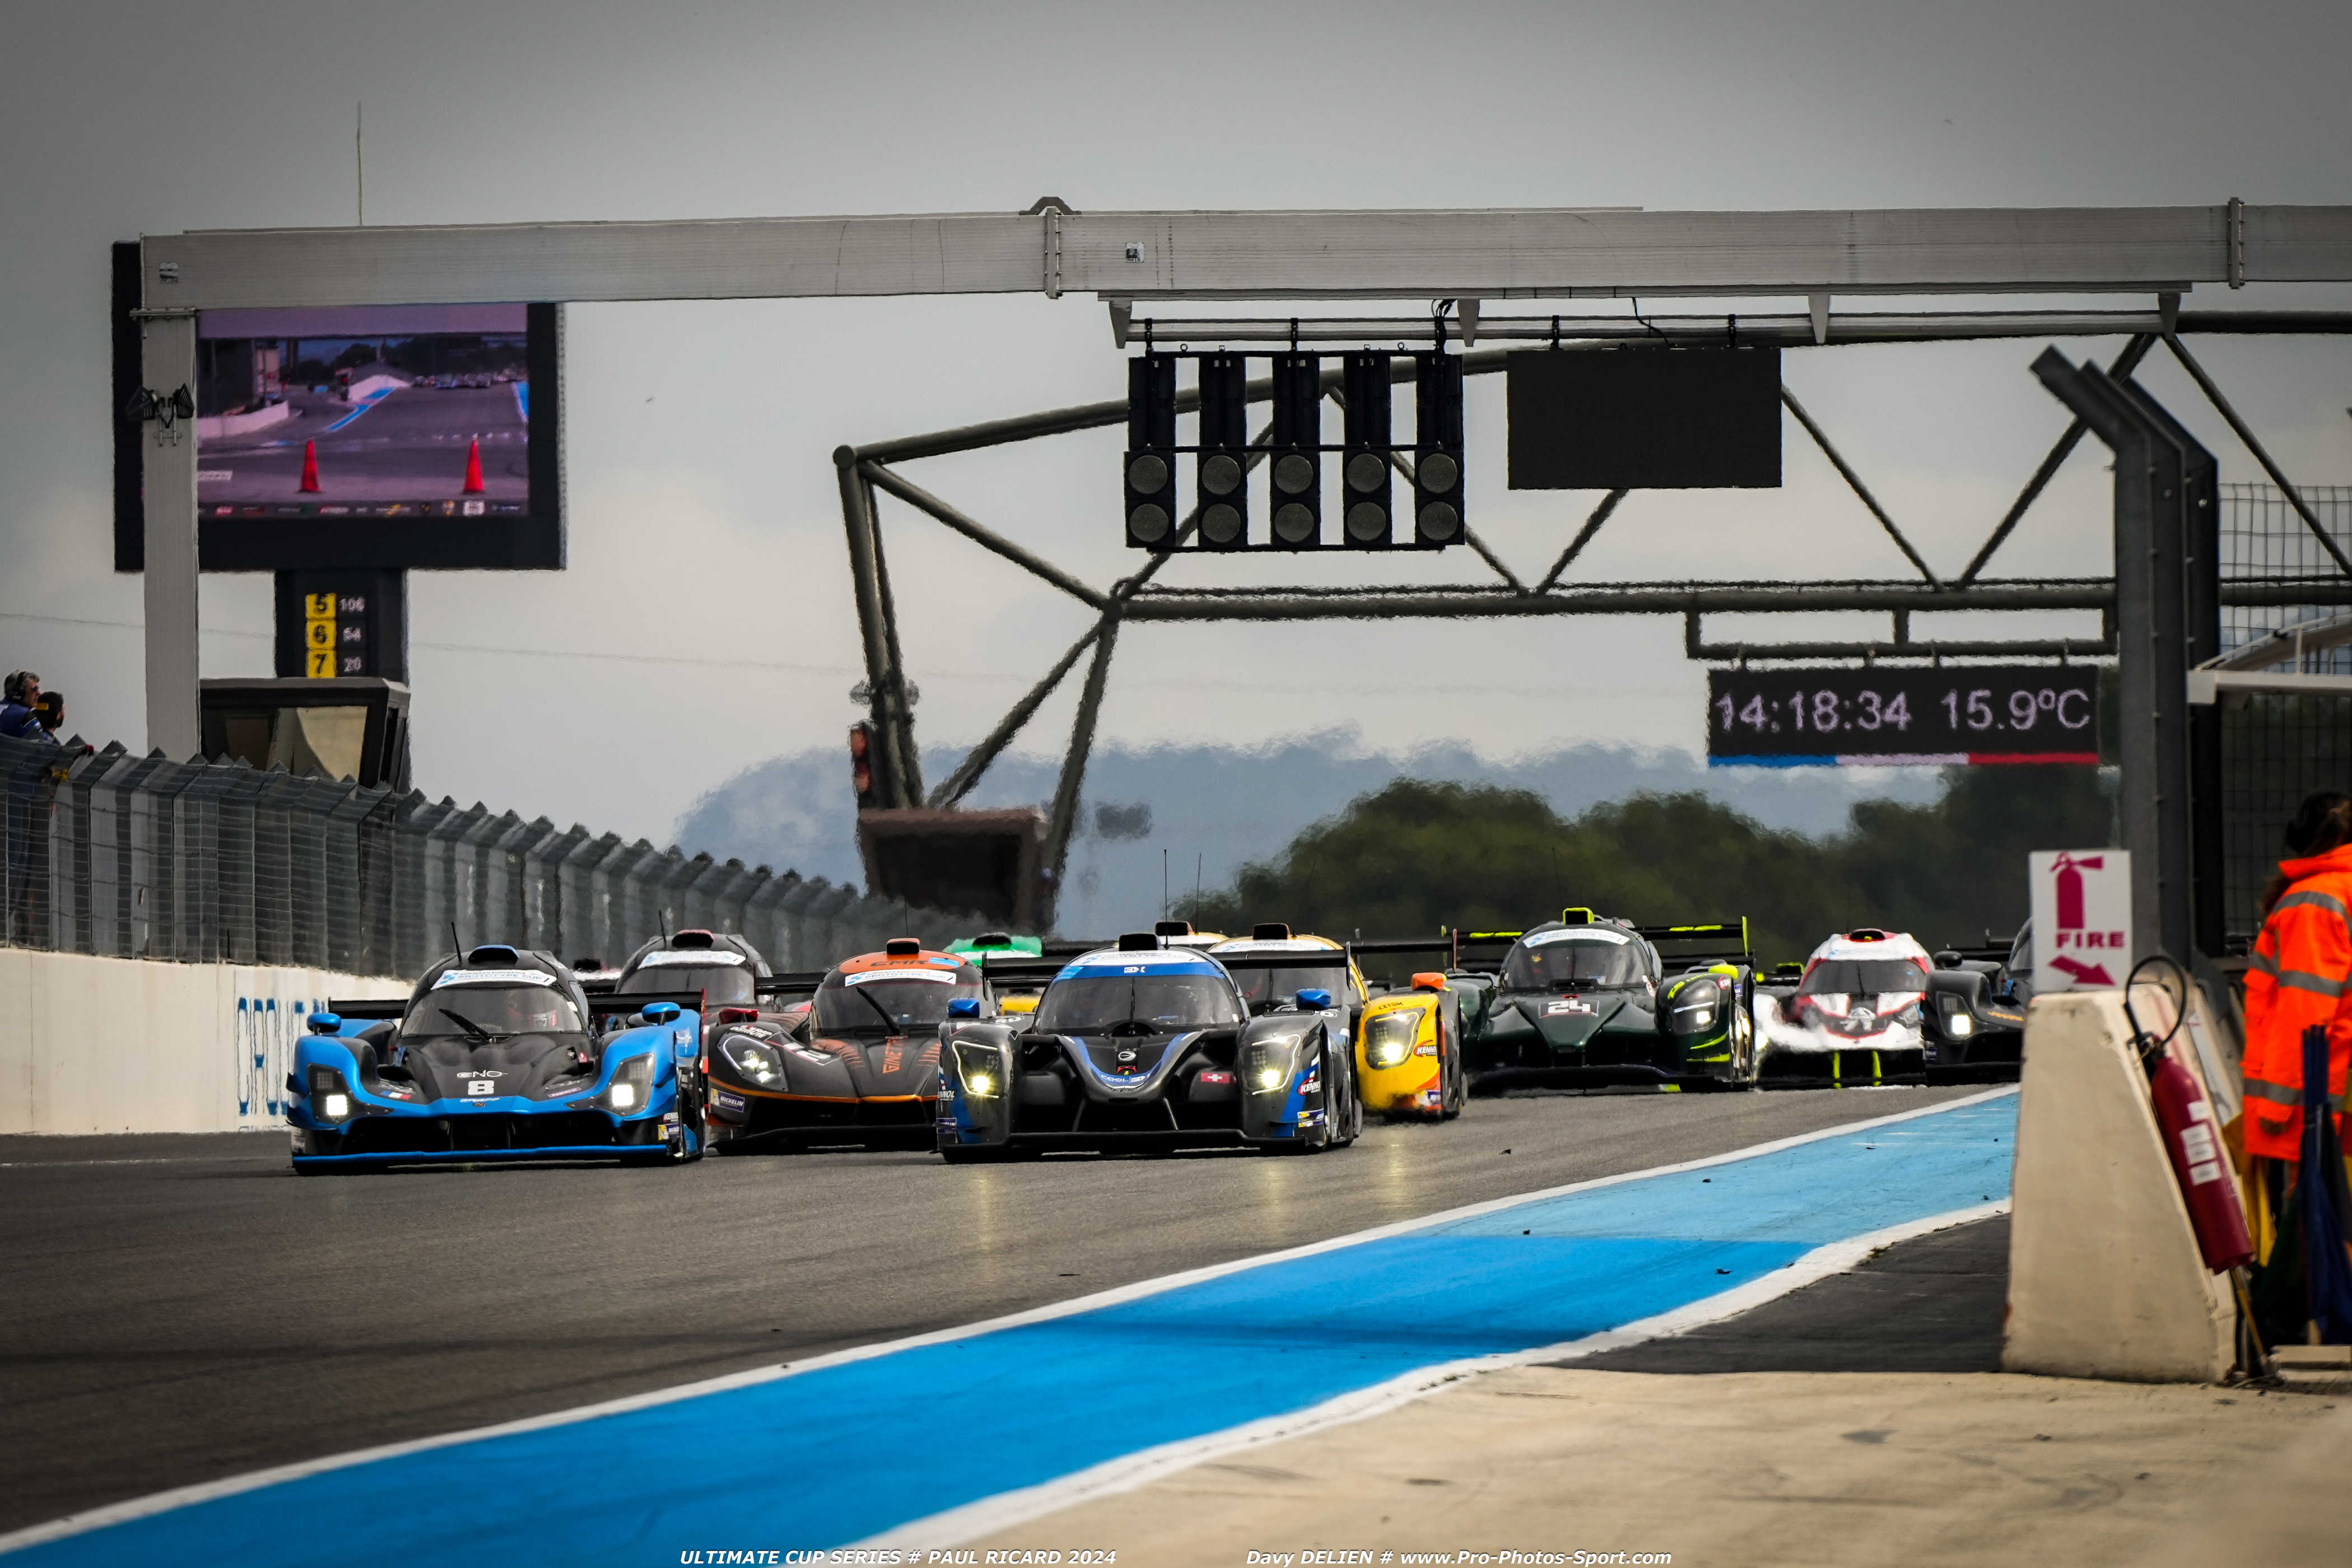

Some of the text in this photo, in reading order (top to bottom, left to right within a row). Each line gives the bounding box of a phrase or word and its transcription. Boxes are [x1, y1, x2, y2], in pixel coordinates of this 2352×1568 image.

[315, 594, 328, 614] 5
[314, 624, 328, 643] 6
[314, 654, 327, 674] 7
[1715, 690, 1911, 730] 14:18:34
[2056, 931, 2125, 949] FIRE
[1548, 1000, 1591, 1013] 24
[468, 1080, 495, 1095] 8
[720, 1095, 744, 1107] MICHELIN
